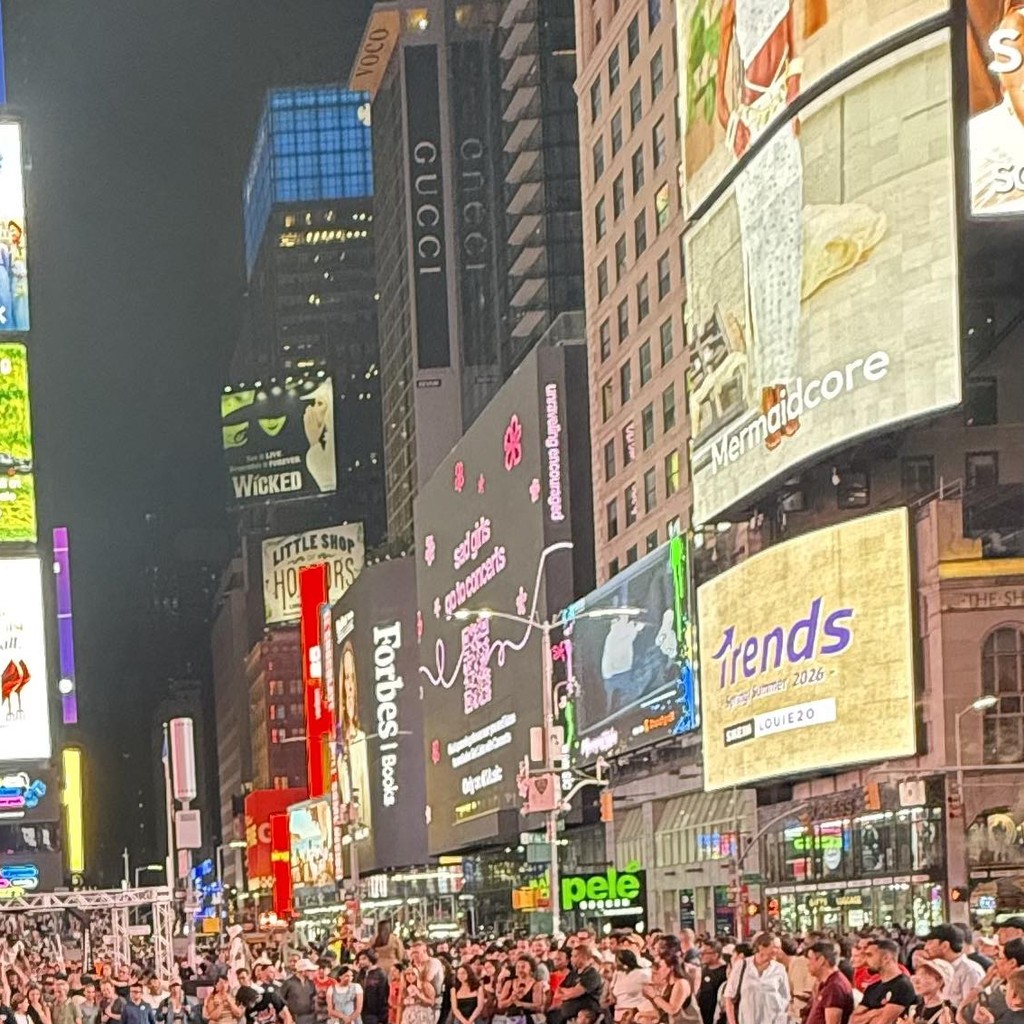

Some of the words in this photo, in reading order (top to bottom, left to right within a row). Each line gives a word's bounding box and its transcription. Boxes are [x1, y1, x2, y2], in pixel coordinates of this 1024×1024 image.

[414, 141, 442, 274] GUCCI
[710, 350, 891, 475] Mermaidcore
[273, 534, 318, 566] LITTLE
[321, 533, 355, 554] SHOP
[712, 597, 854, 688] Trends
[792, 667, 825, 686] 2026
[374, 621, 404, 741] Forbes
[381, 754, 399, 807] Books
[562, 859, 640, 911] pelé
